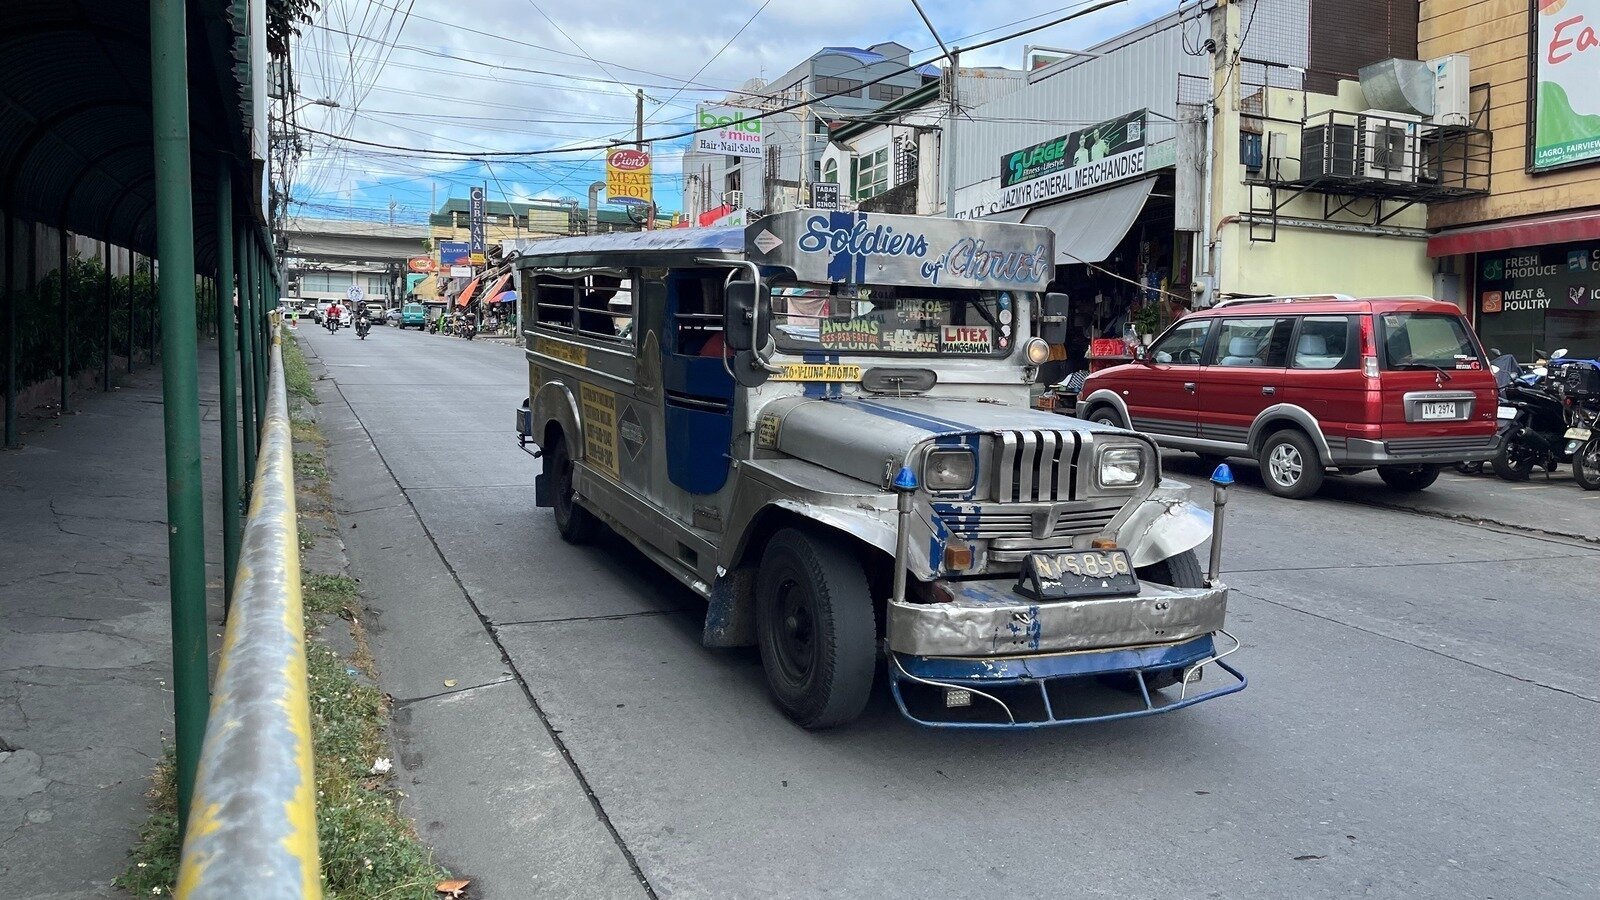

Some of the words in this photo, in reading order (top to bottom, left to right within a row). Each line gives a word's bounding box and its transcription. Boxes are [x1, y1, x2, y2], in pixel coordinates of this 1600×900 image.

[1547, 15, 1600, 65] Ea
[700, 107, 761, 134] bella
[611, 152, 648, 167] Cion's
[1009, 140, 1065, 182] SURGE
[1538, 147, 1565, 159] LAGRO,
[609, 170, 649, 186] MEAT
[1001, 184, 1032, 209] JAZMYR
[1033, 172, 1073, 200] GENERAL
[1074, 151, 1144, 189] MERCHANDISE
[609, 183, 648, 198] SHOP
[798, 214, 929, 257] Soldiers
[441, 246, 467, 254] VILLARICA
[920, 255, 945, 285] of
[1505, 255, 1538, 269] FRESH
[1505, 264, 1557, 279] PRODUCE
[1504, 288, 1535, 301] MEAT
[1536, 287, 1546, 299] &
[1504, 299, 1552, 311] POULTRY
[822, 319, 880, 335] ANONAS
[944, 327, 988, 343] LITEX
[942, 341, 990, 353] MANGGAHAN
[1083, 552, 1128, 576] 856
